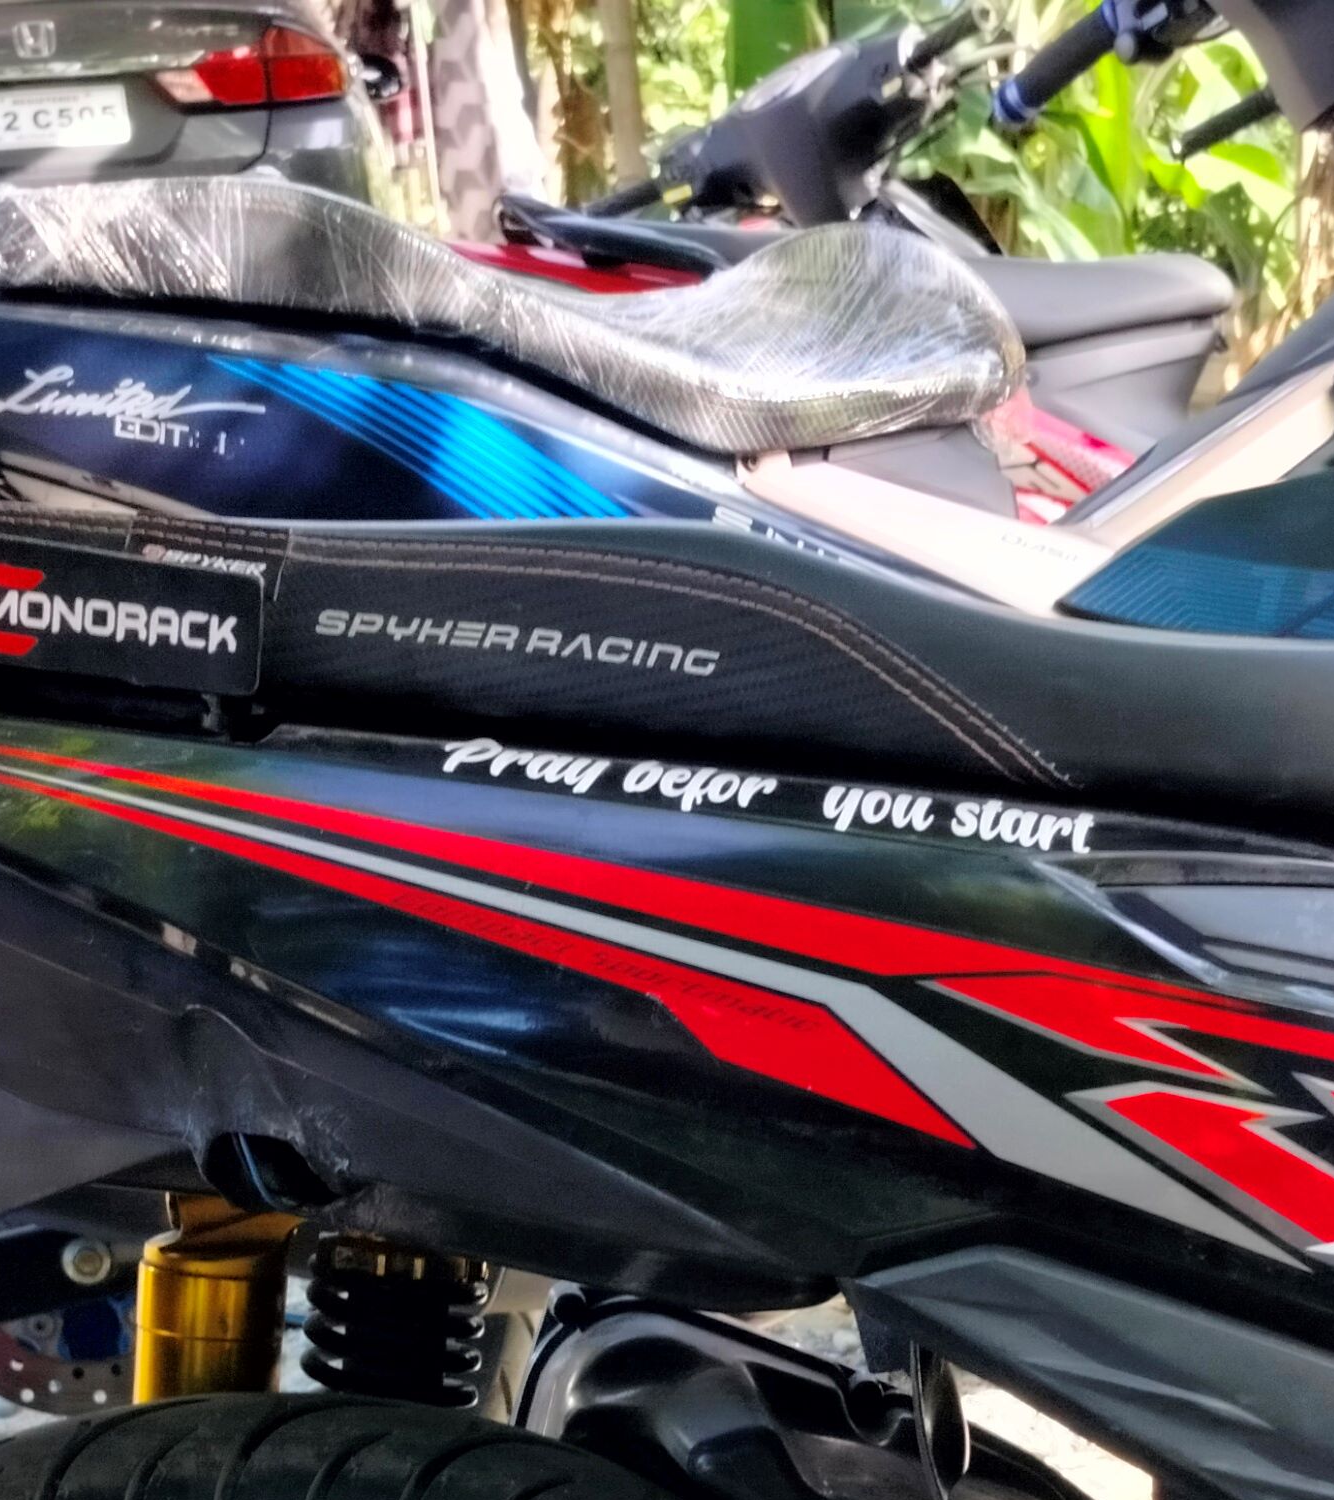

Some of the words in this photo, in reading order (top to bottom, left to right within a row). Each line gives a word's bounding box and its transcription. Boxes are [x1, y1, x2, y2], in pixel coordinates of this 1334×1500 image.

[314, 608, 519, 653] SPYKER
[524, 629, 720, 678] RACING
[442, 736, 611, 794] Pray
[822, 785, 935, 832] you
[950, 800, 1094, 855] start
